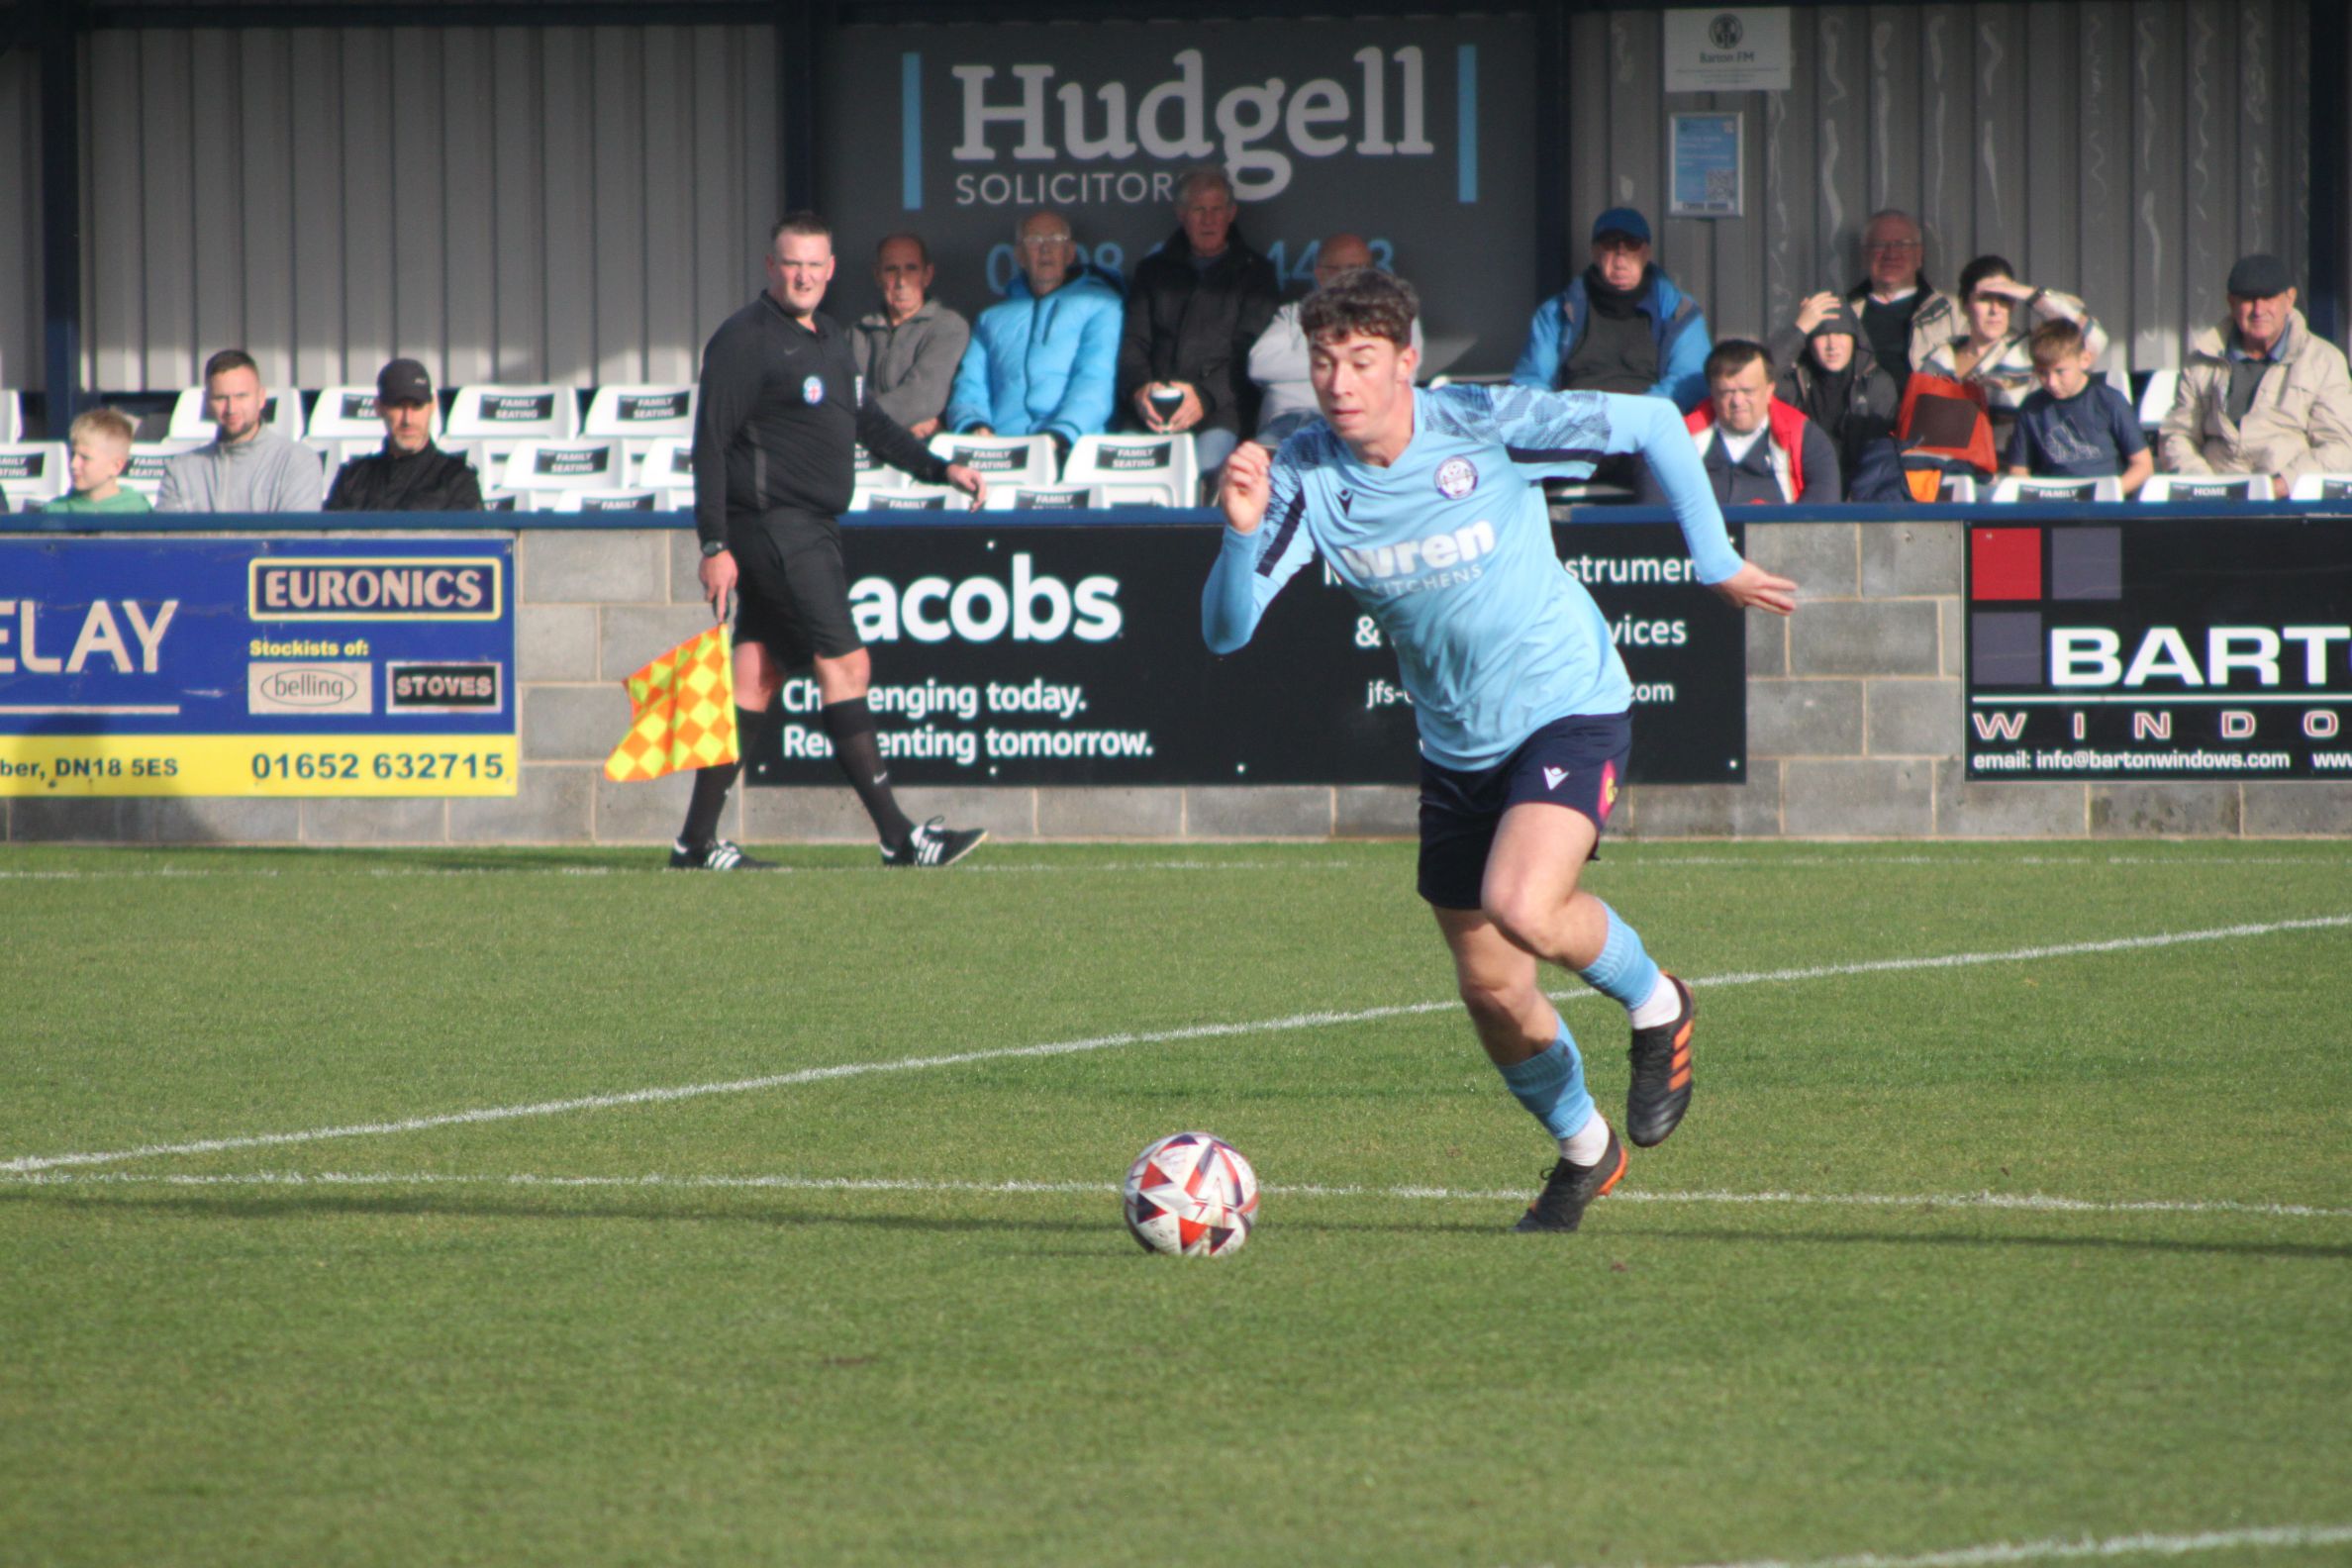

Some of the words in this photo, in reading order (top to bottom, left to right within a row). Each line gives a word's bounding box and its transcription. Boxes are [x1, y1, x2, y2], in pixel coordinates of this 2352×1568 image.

[951, 46, 1434, 201] Hudgell
[955, 172, 1178, 205] SOLICITOR
[264, 569, 483, 608] EURONICS
[847, 552, 1123, 642] acobs
[1354, 615, 1382, 647] &
[249, 638, 340, 657] Stockists
[343, 638, 369, 657] of:
[2050, 627, 2351, 686] BART
[274, 672, 343, 702] belling
[396, 676, 493, 698] STOVES
[782, 678, 978, 720] Chenging
[987, 678, 1088, 719] today.
[986, 727, 1153, 757] tomorrow.
[55, 758, 122, 777] DN18
[132, 758, 179, 777] 5ES
[251, 753, 359, 779] 01652
[373, 752, 504, 779] 632715
[1973, 750, 2031, 769] email:
[2036, 750, 2291, 769] info@bartonwindows.com
